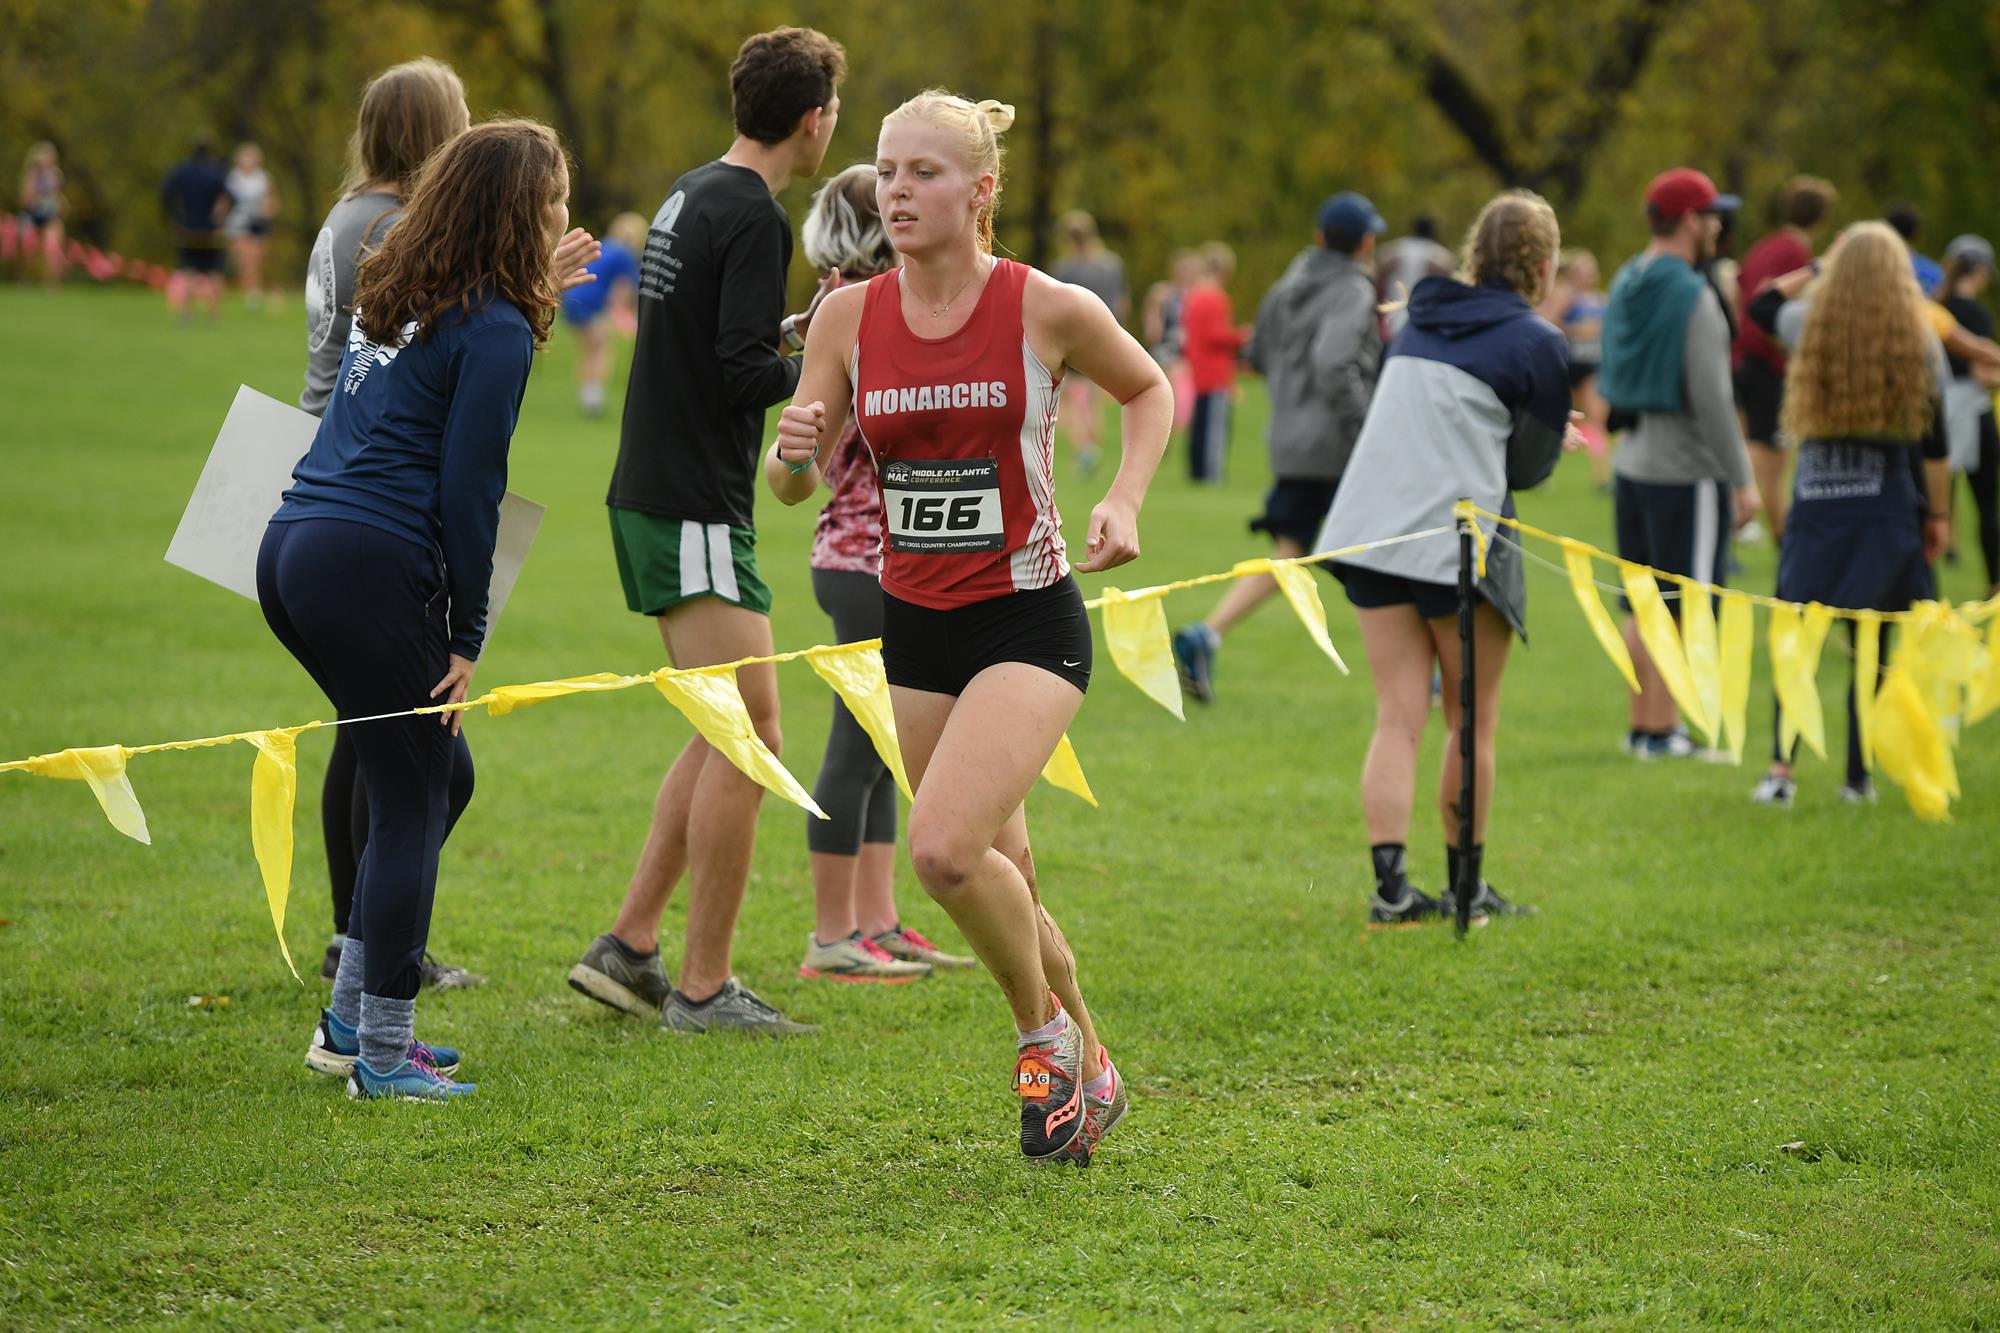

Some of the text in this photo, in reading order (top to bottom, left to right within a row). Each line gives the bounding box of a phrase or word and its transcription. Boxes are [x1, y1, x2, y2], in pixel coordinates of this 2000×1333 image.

[348, 339, 379, 382] ONIANS
[864, 381, 1007, 417] MONARCHS
[911, 467, 991, 477] MIDDLE ATLANTIC
[887, 473, 909, 482] MAC
[900, 496, 984, 531] 166
[947, 540, 991, 548] CHAMPIONSHIP
[1024, 1074, 1047, 1084] 16
